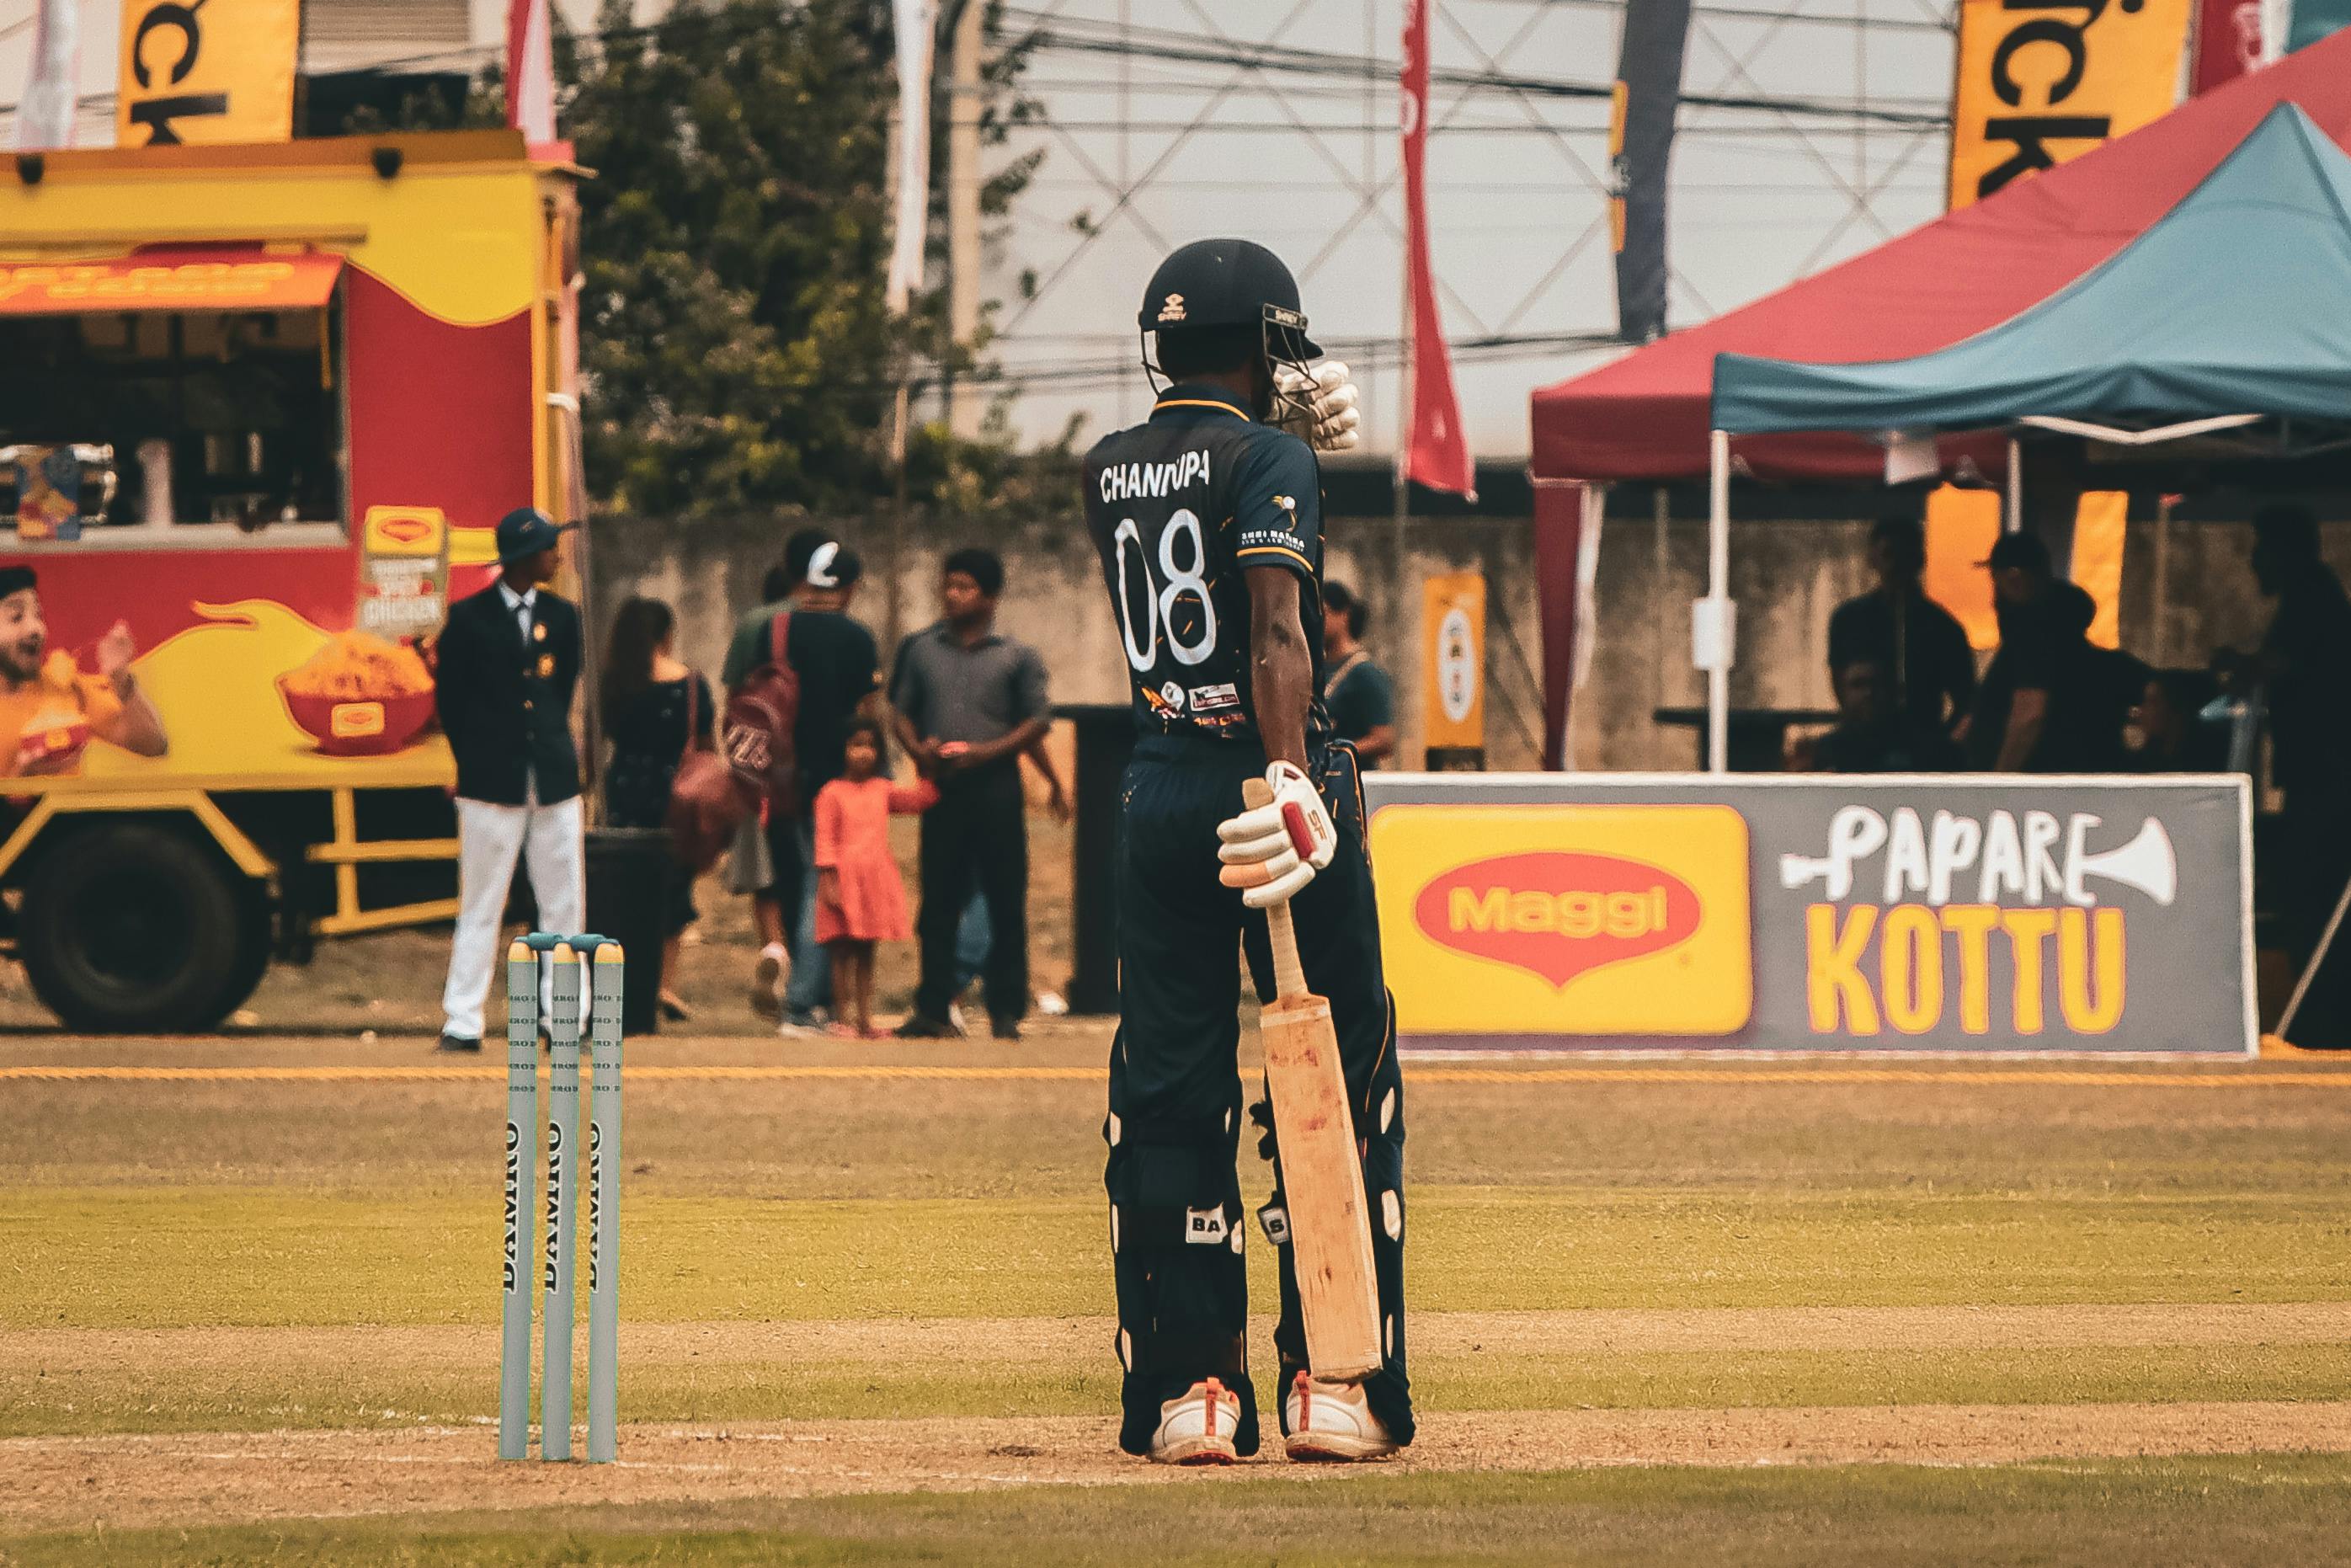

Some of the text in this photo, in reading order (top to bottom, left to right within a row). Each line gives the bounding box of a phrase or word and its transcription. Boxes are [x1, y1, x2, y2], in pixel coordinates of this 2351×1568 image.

[1114, 508, 1217, 673] 08
[1825, 804, 2105, 907] PAPARE
[1447, 885, 1668, 939] Maggi
[1805, 903, 2127, 1037] KOTTU
[1191, 1217, 1221, 1233] BA
